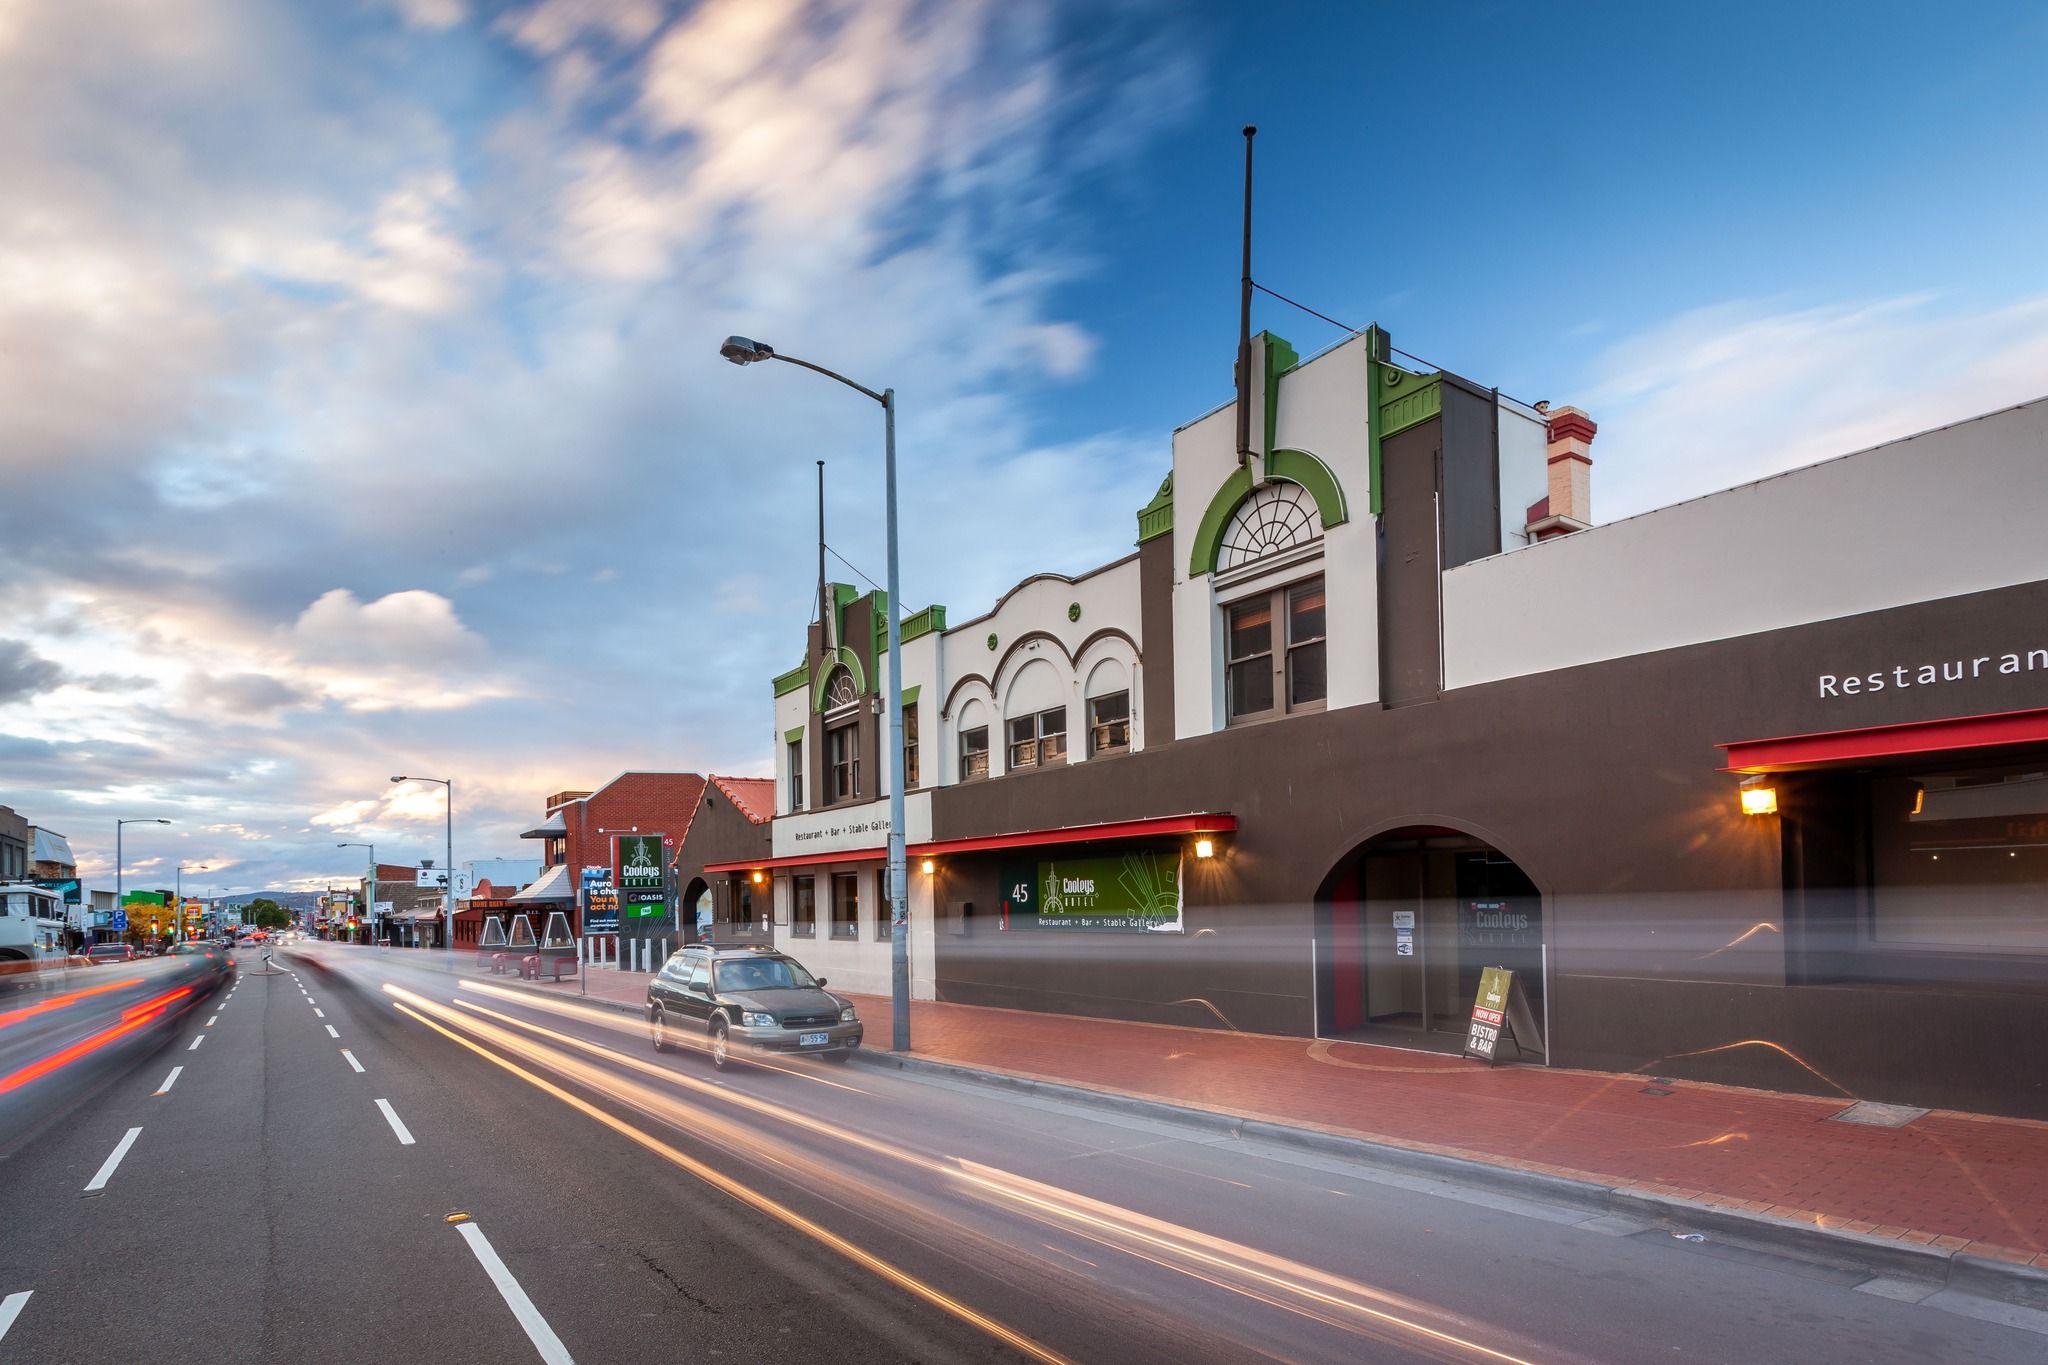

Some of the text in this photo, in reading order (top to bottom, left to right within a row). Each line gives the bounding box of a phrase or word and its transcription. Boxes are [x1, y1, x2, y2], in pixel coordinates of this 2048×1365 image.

[795, 829, 822, 841] Restaurant
[830, 827, 840, 837] Bar
[849, 823, 868, 834] Stable
[664, 838, 674, 846] 45
[623, 865, 660, 877] Cooleys
[1012, 883, 1028, 903] 45
[1063, 878, 1095, 895] Cooleys
[1039, 918, 1071, 926] Restaurant
[1081, 918, 1092, 926] Bar
[1103, 918, 1126, 927] Stable
[1476, 911, 1528, 931] Cooleys
[1475, 1009, 1501, 1023] NOW OPEN
[1471, 1024, 1497, 1041] BISTRO
[1470, 1037, 1493, 1054] & BAR
